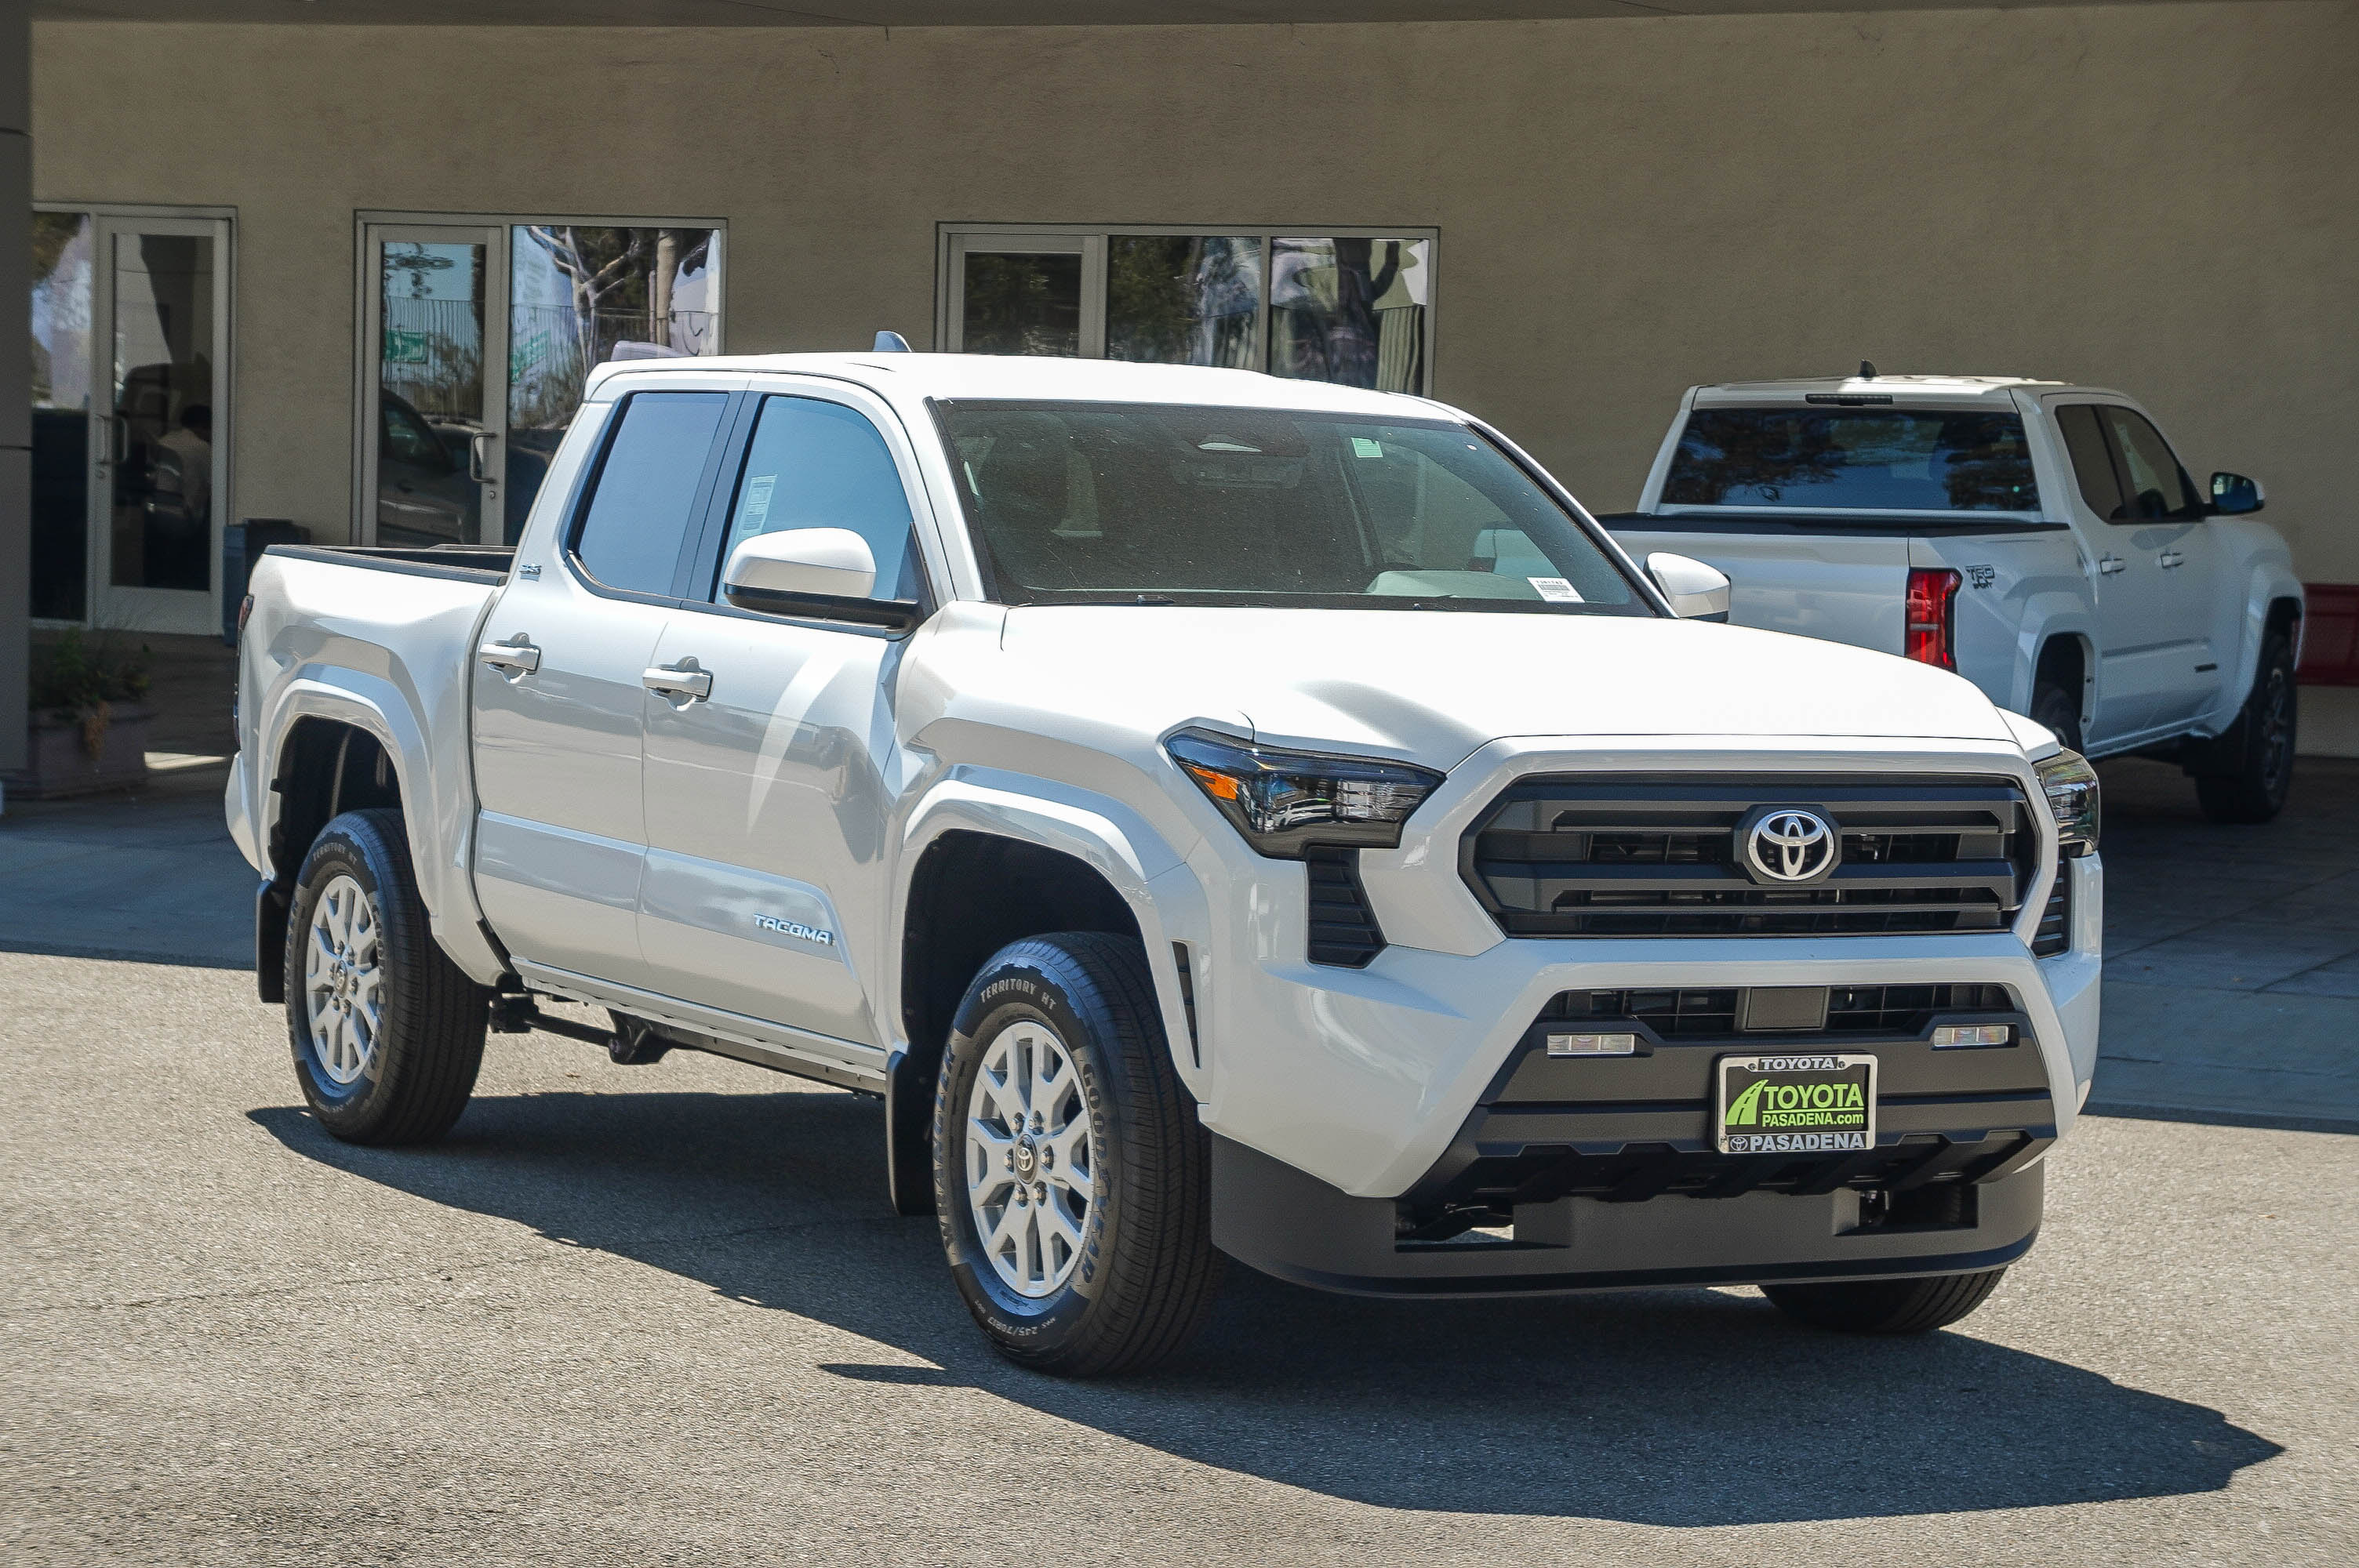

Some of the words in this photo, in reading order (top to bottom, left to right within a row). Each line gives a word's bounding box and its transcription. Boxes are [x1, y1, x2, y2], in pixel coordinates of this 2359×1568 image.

[753, 913, 833, 946] TACOMA
[980, 978, 1037, 1004] TERRITORY
[1761, 1058, 1835, 1070] TOYOTA
[1764, 1083, 1864, 1109] TOYOTA
[1761, 1112, 1864, 1127] PASADENA.com
[1750, 1133, 1865, 1152] PASADENA
